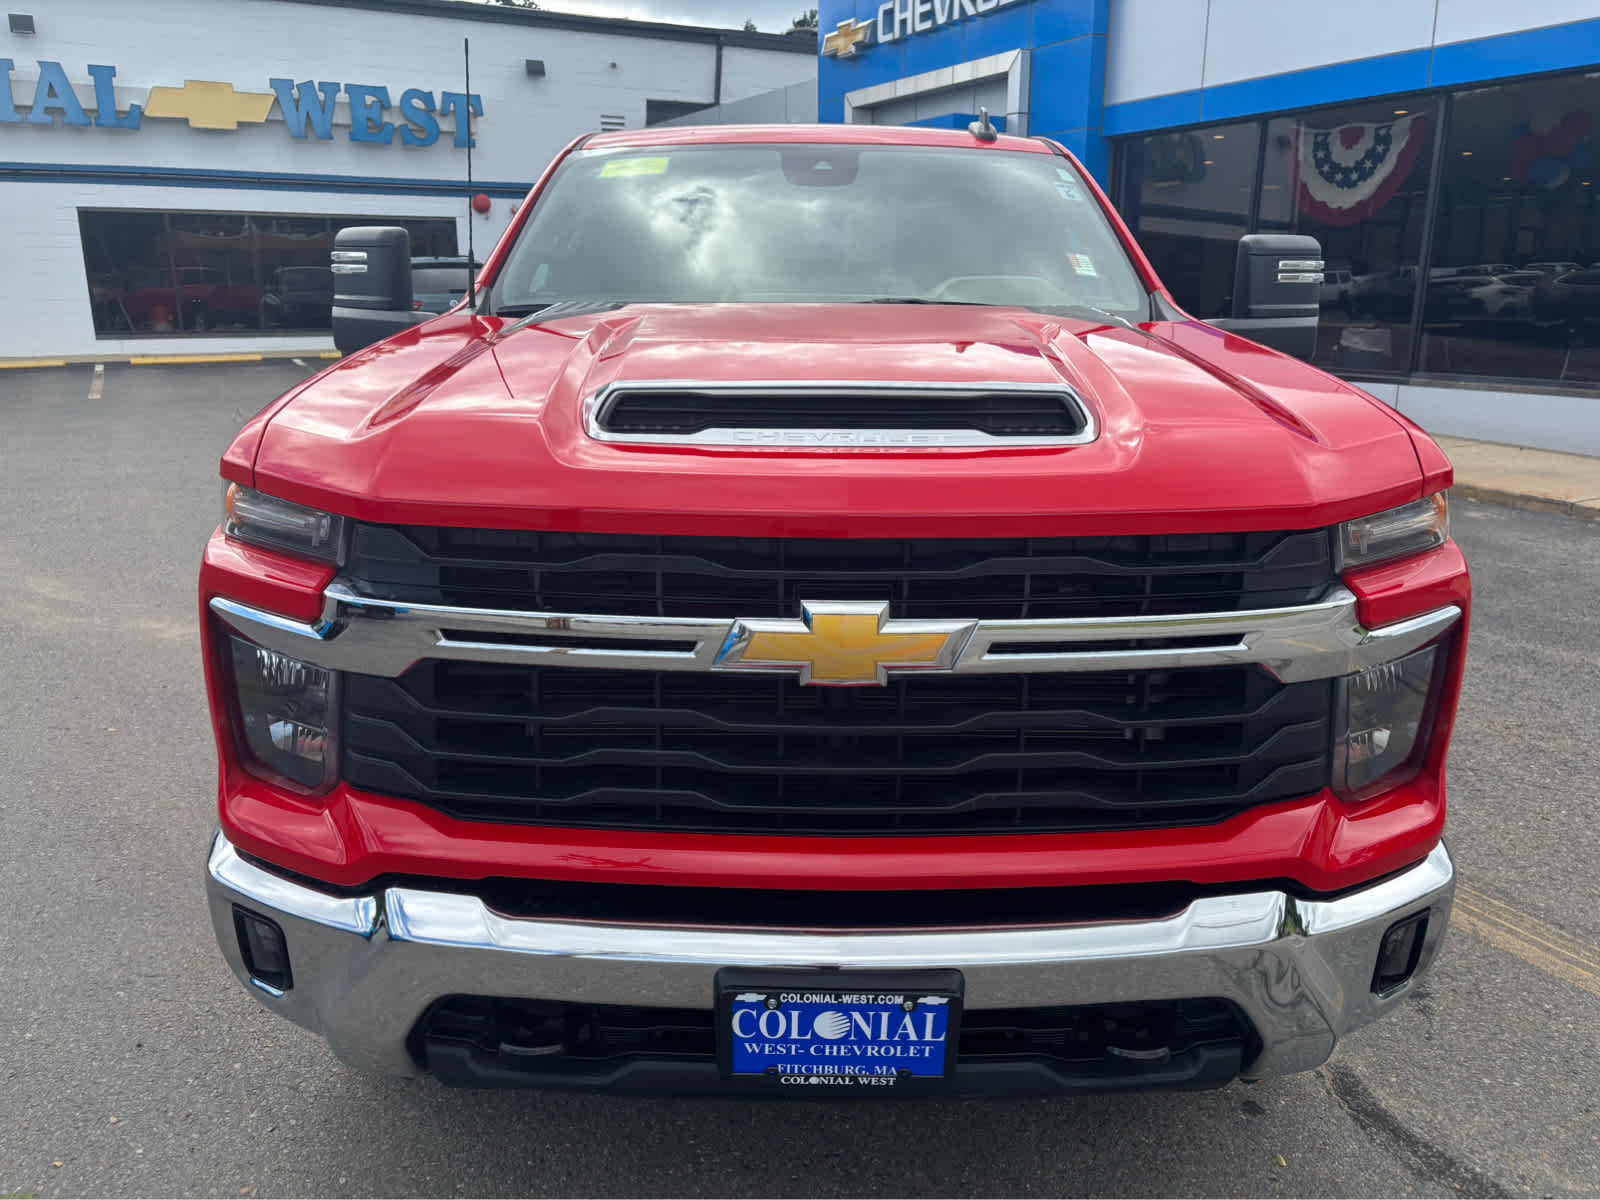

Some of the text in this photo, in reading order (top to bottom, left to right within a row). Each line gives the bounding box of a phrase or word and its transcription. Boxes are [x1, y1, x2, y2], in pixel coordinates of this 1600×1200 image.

[269, 78, 484, 149] WEST
[779, 992, 904, 1005] COLONIAL-WEST.COM
[809, 1044, 935, 1057] CHEVROLET
[874, 1065, 898, 1076] MA
[858, 1076, 897, 1086] WEST
